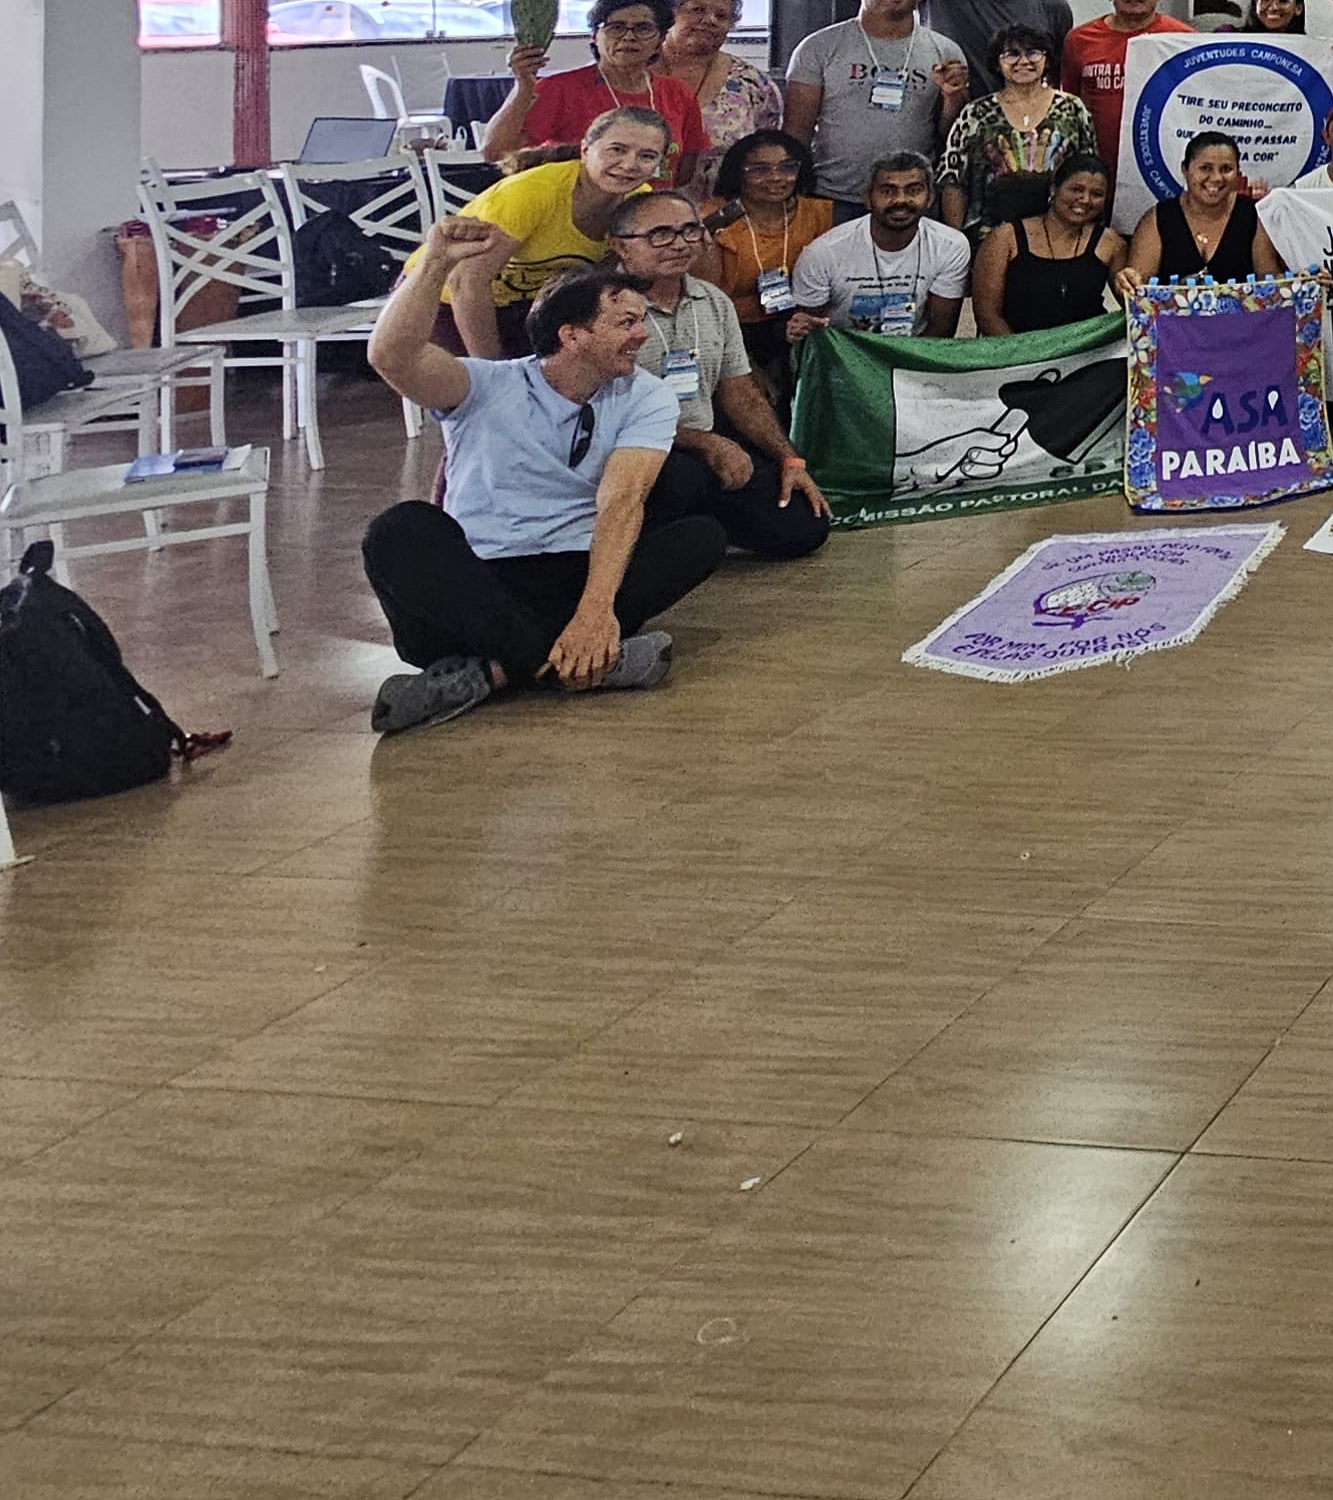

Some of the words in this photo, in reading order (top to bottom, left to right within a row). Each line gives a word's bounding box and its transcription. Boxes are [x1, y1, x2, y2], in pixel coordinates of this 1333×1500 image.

[1184, 47, 1246, 69] JUVENTUDES
[1208, 99, 1228, 110] SEU
[1231, 101, 1303, 113] PRECONCEITO
[1199, 114, 1214, 126] DO
[1254, 135, 1298, 146] PASSAR
[1201, 385, 1288, 436] ASA
[1162, 438, 1301, 481] PARAÍBA
